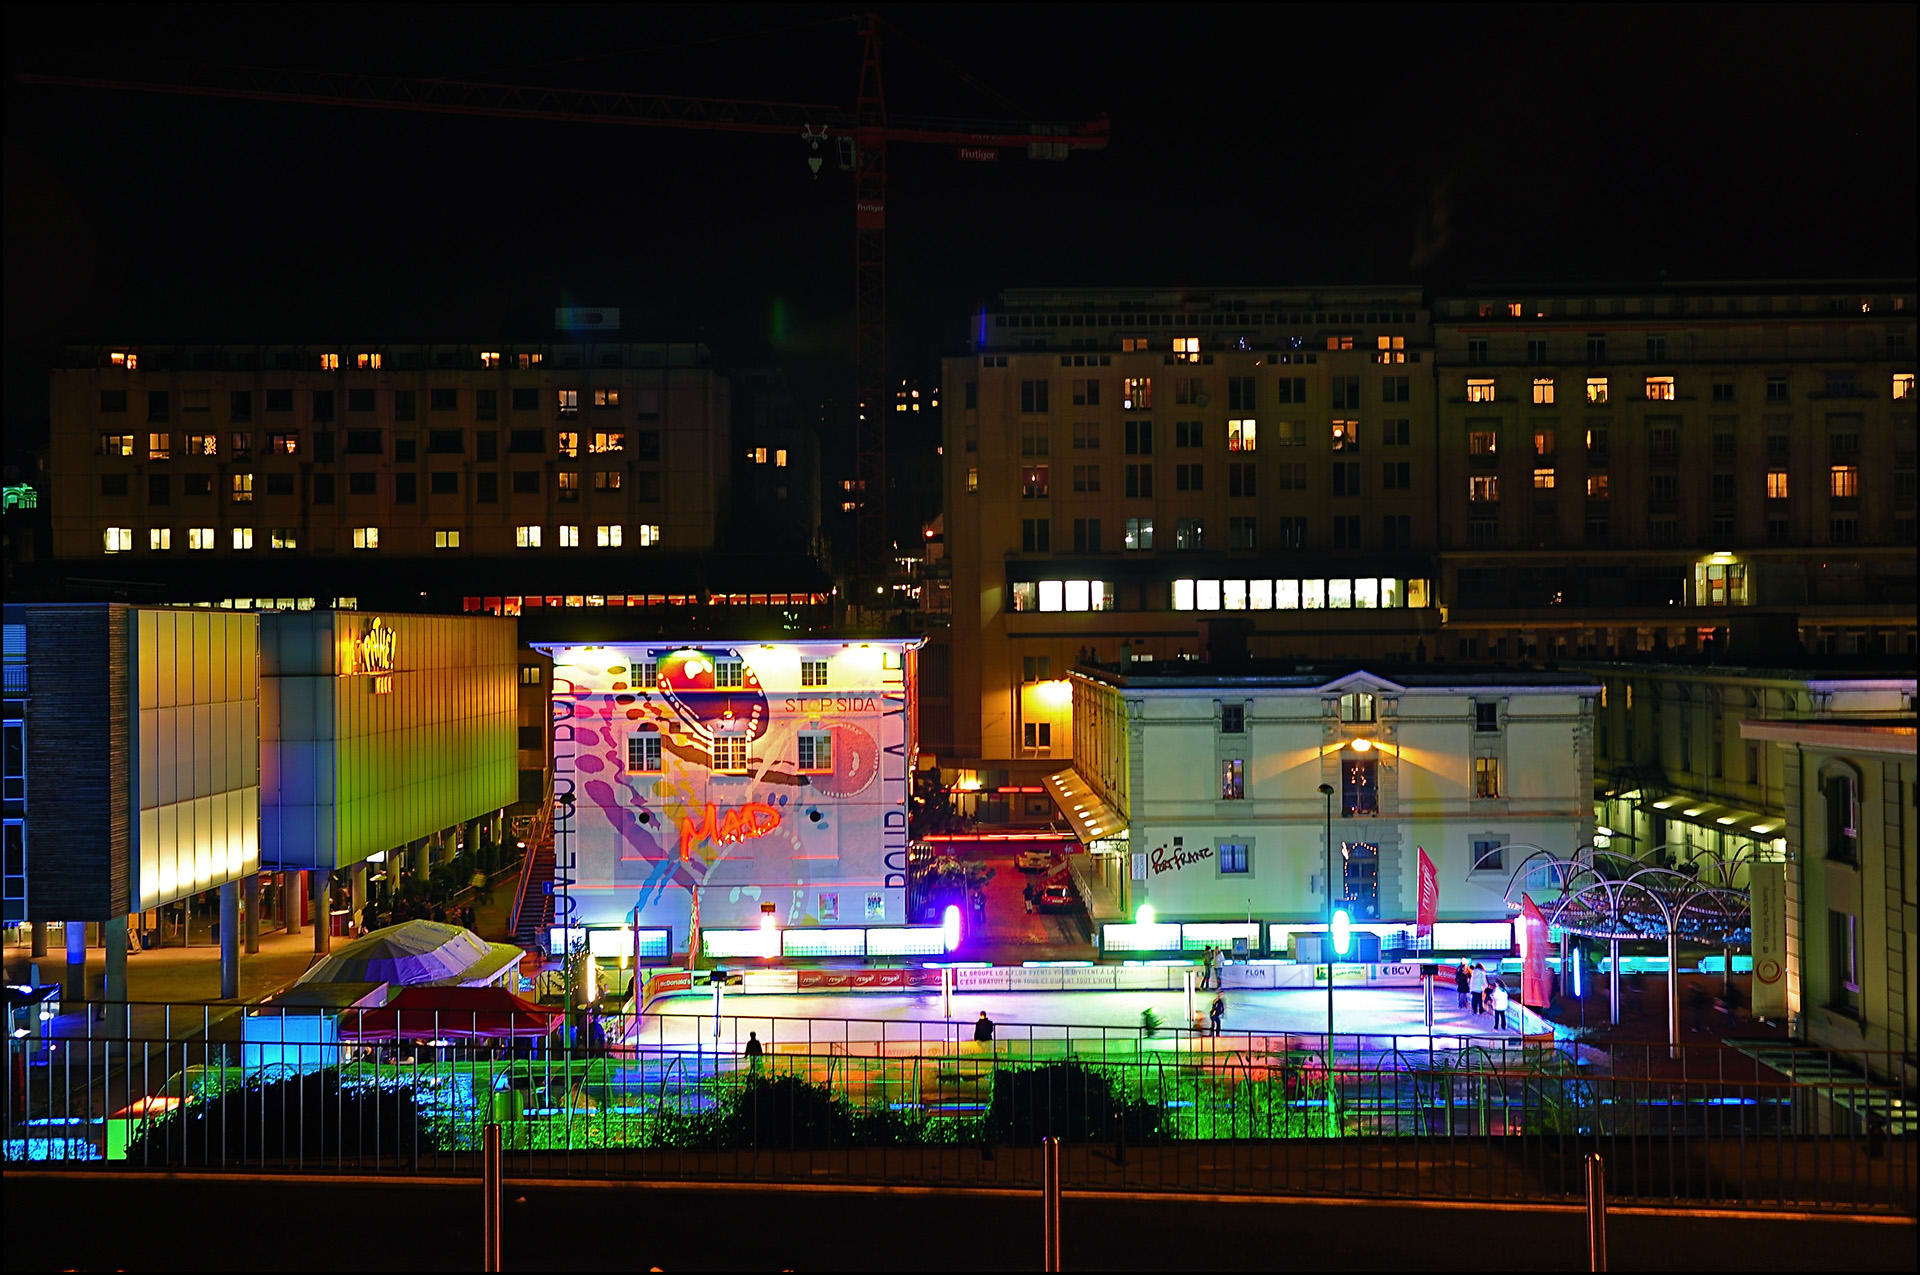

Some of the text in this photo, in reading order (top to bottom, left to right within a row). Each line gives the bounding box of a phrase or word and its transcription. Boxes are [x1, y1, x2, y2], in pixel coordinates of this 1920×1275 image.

[961, 147, 995, 160] Frutiger
[857, 203, 885, 213] Frutiger
[837, 697, 876, 712] SIDA
[681, 801, 781, 862] MAD
[884, 811, 905, 889] POUR
[1245, 969, 1265, 977] FLON
[1391, 966, 1412, 976] BCV
